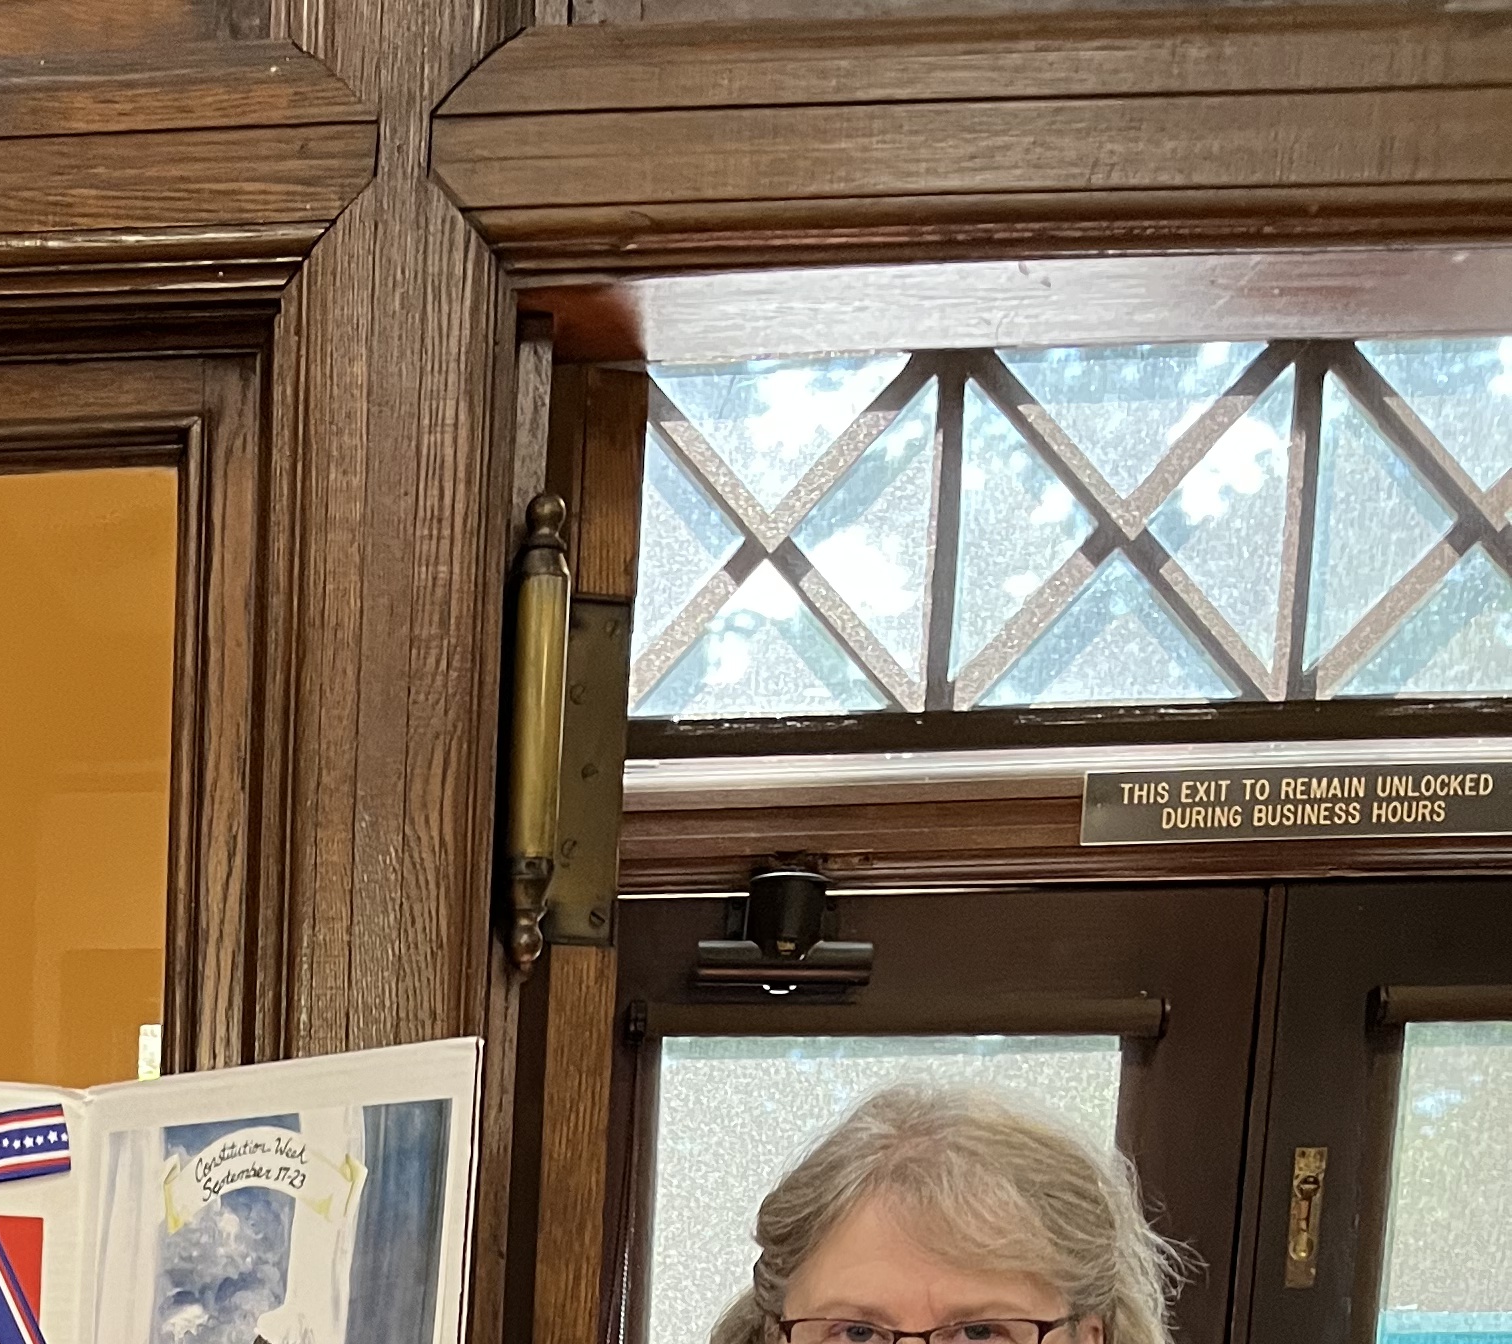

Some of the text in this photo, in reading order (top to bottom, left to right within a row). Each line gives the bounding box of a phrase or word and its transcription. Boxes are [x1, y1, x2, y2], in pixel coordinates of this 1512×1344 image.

[1120, 774, 1494, 805] THIS EXIT TO REMAIN UNLOCKED
[1162, 801, 1446, 829] DURING BUSINESS HOURS
